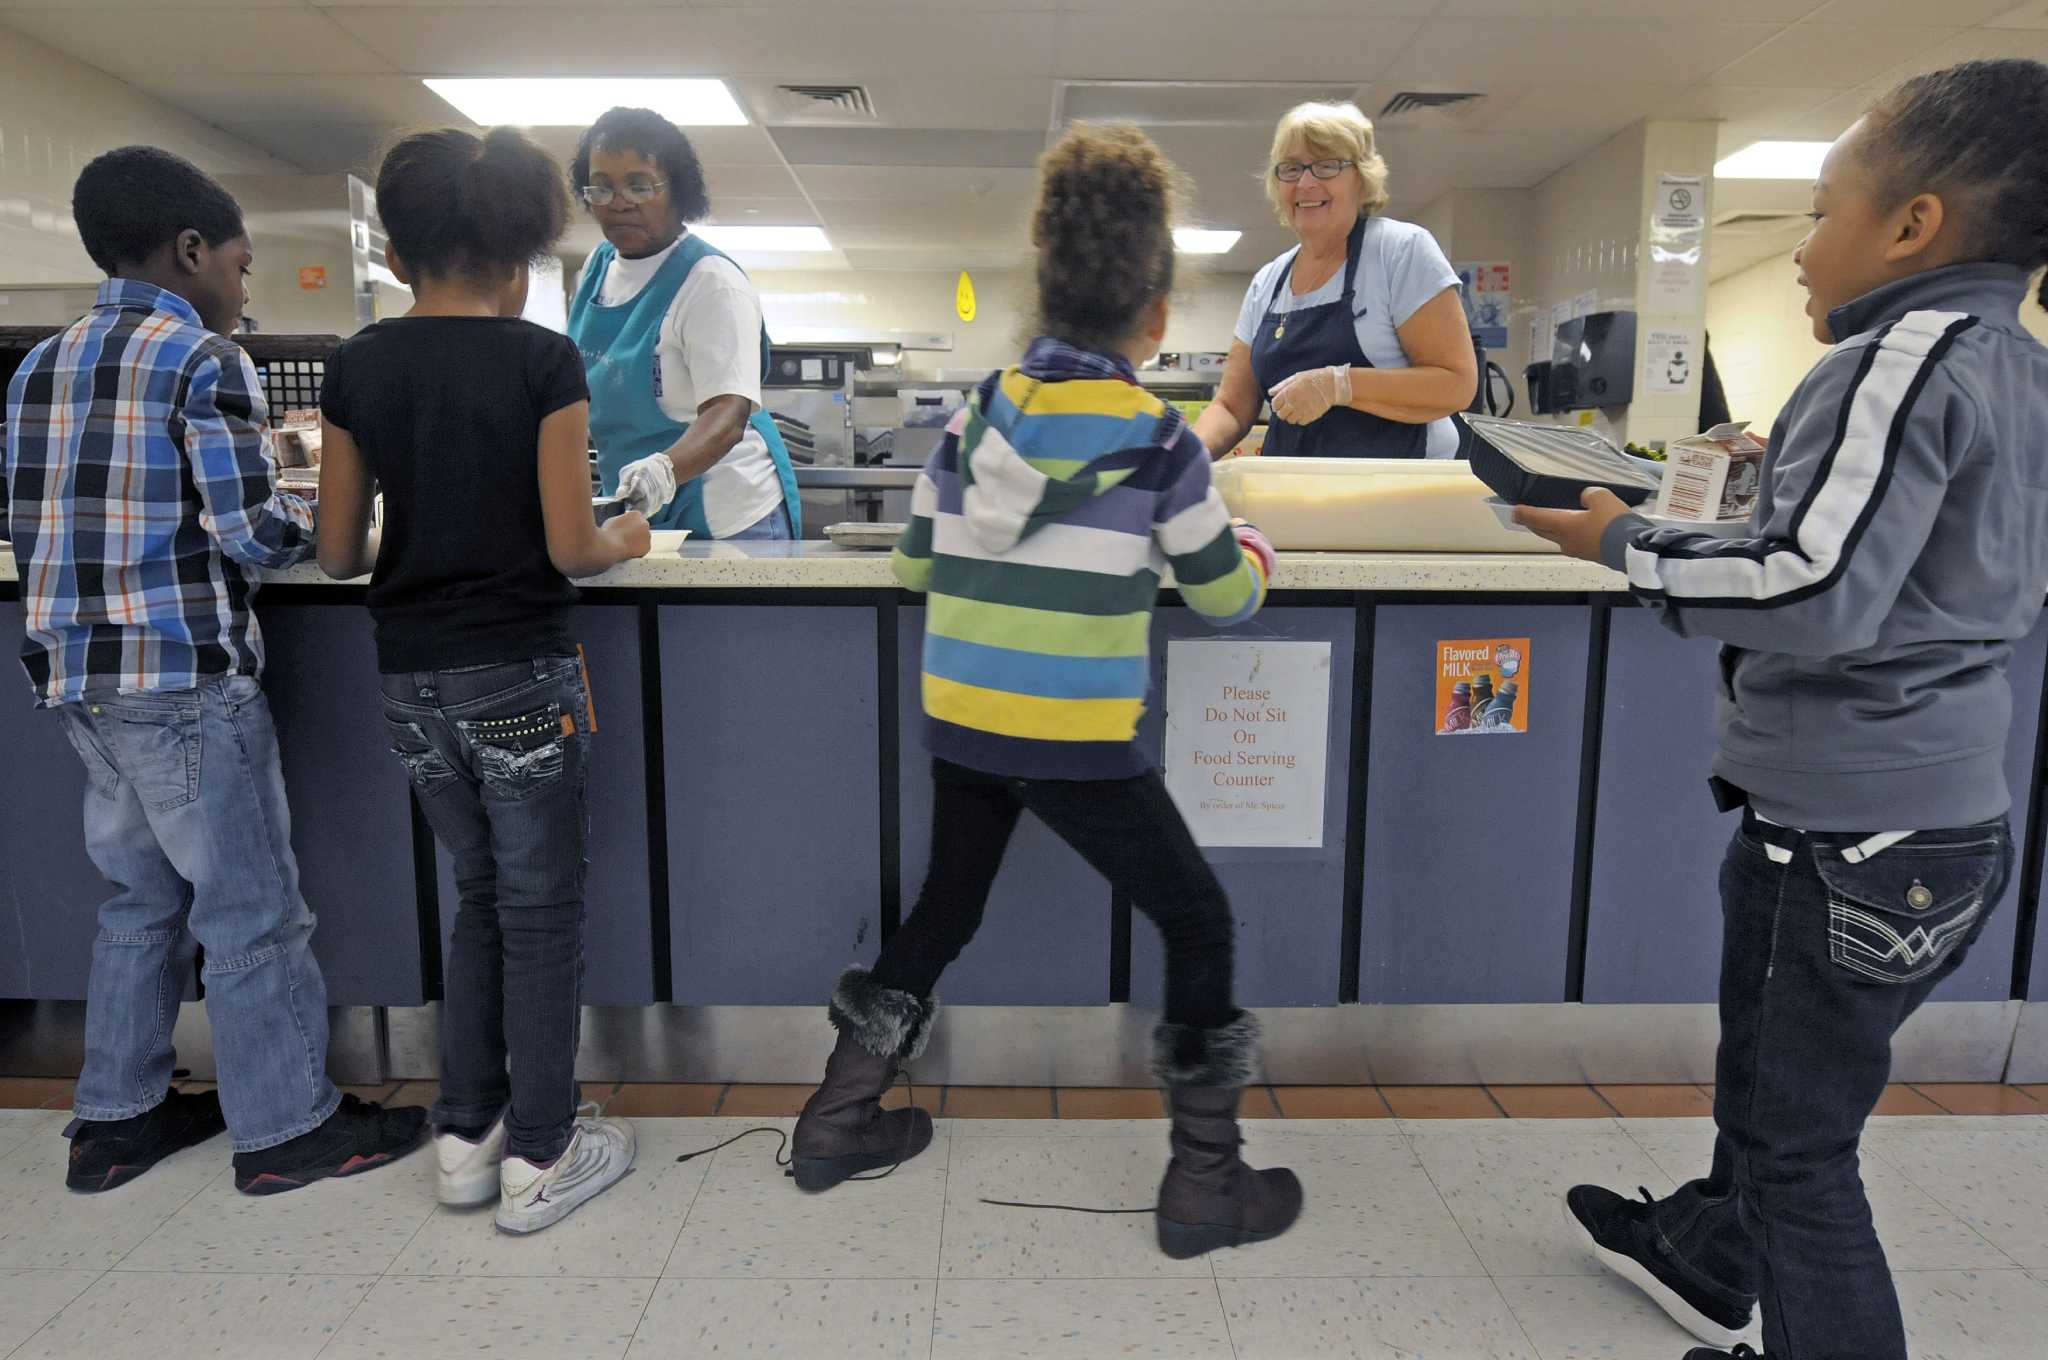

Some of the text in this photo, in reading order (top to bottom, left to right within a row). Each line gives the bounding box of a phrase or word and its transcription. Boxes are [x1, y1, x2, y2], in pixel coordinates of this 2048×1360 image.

[1443, 646, 1489, 661] Flavored
[1443, 663, 1472, 677] MILK
[1223, 686, 1271, 701] Please
[1205, 708, 1287, 722] Do Not Sit
[1233, 729, 1256, 744] On
[1193, 751, 1296, 768] Food Serving
[1213, 771, 1275, 786] Counter
